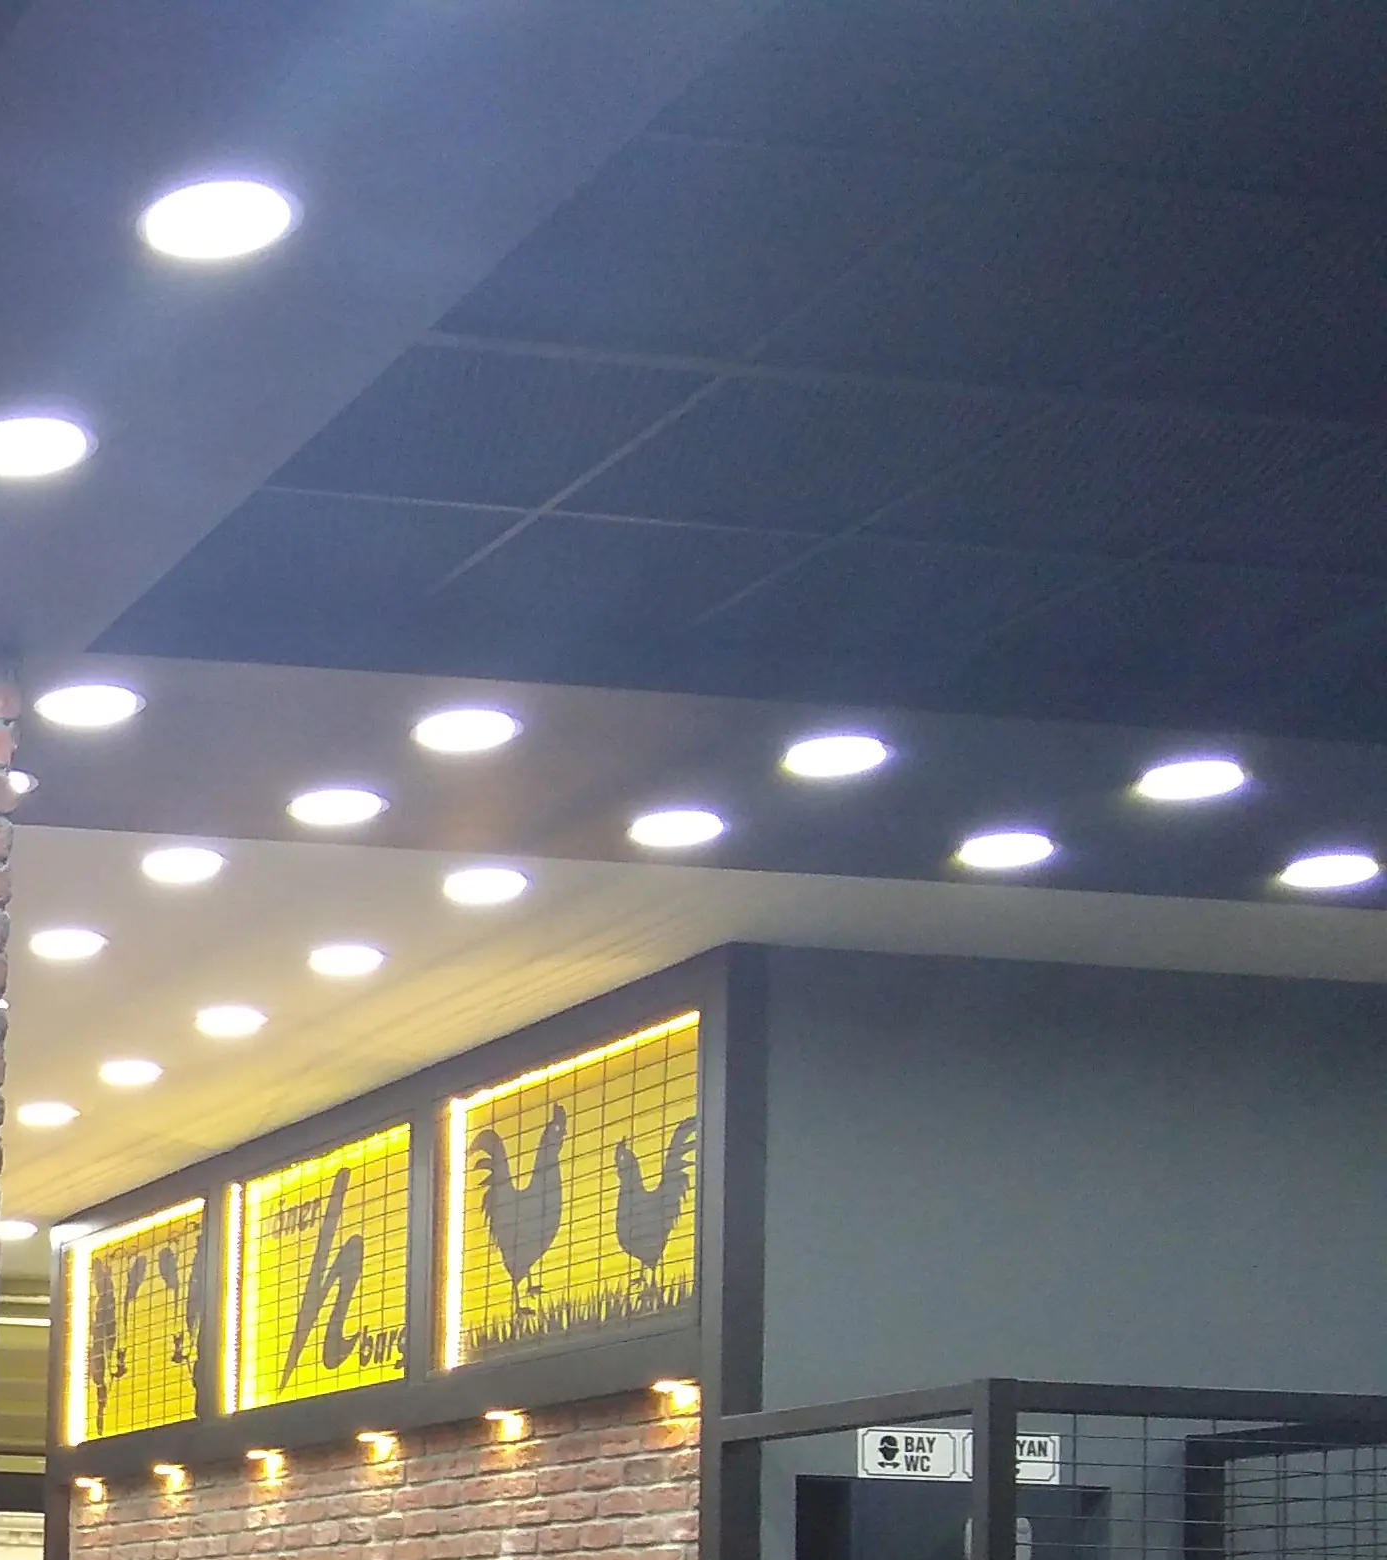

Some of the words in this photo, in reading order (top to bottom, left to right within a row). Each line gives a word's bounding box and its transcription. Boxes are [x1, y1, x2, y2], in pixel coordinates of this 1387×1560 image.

[904, 1436, 936, 1453] BAY
[1017, 1439, 1048, 1457] YAN
[904, 1455, 931, 1472] WC
